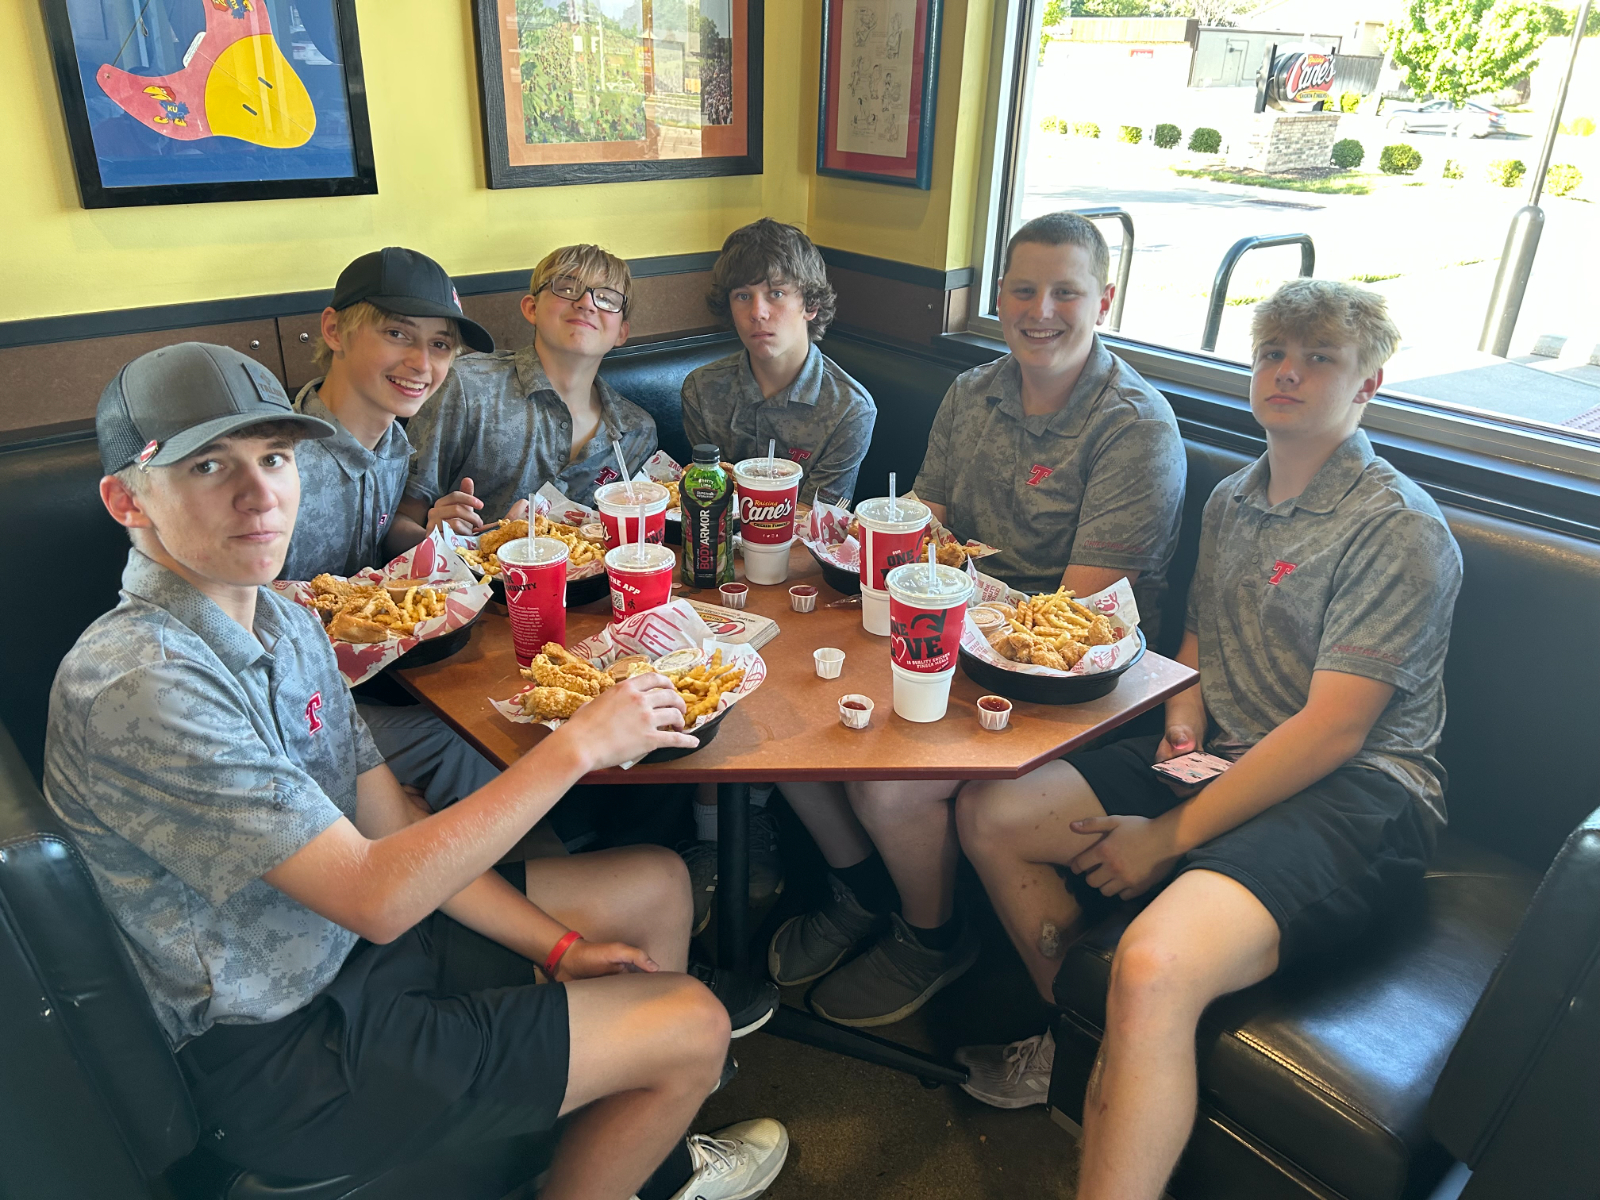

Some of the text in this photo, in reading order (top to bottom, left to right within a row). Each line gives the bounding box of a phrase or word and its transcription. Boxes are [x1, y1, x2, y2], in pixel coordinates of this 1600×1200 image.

[1287, 53, 1336, 99] Cane's
[167, 105, 178, 113] KU
[594, 466, 618, 486] T
[1026, 464, 1054, 486] T
[740, 496, 793, 524] Cane's
[700, 509, 710, 570] BODYARMOR
[886, 549, 914, 567] ONE
[1268, 559, 1298, 586] T
[622, 583, 641, 595] APP
[305, 691, 323, 736] T
